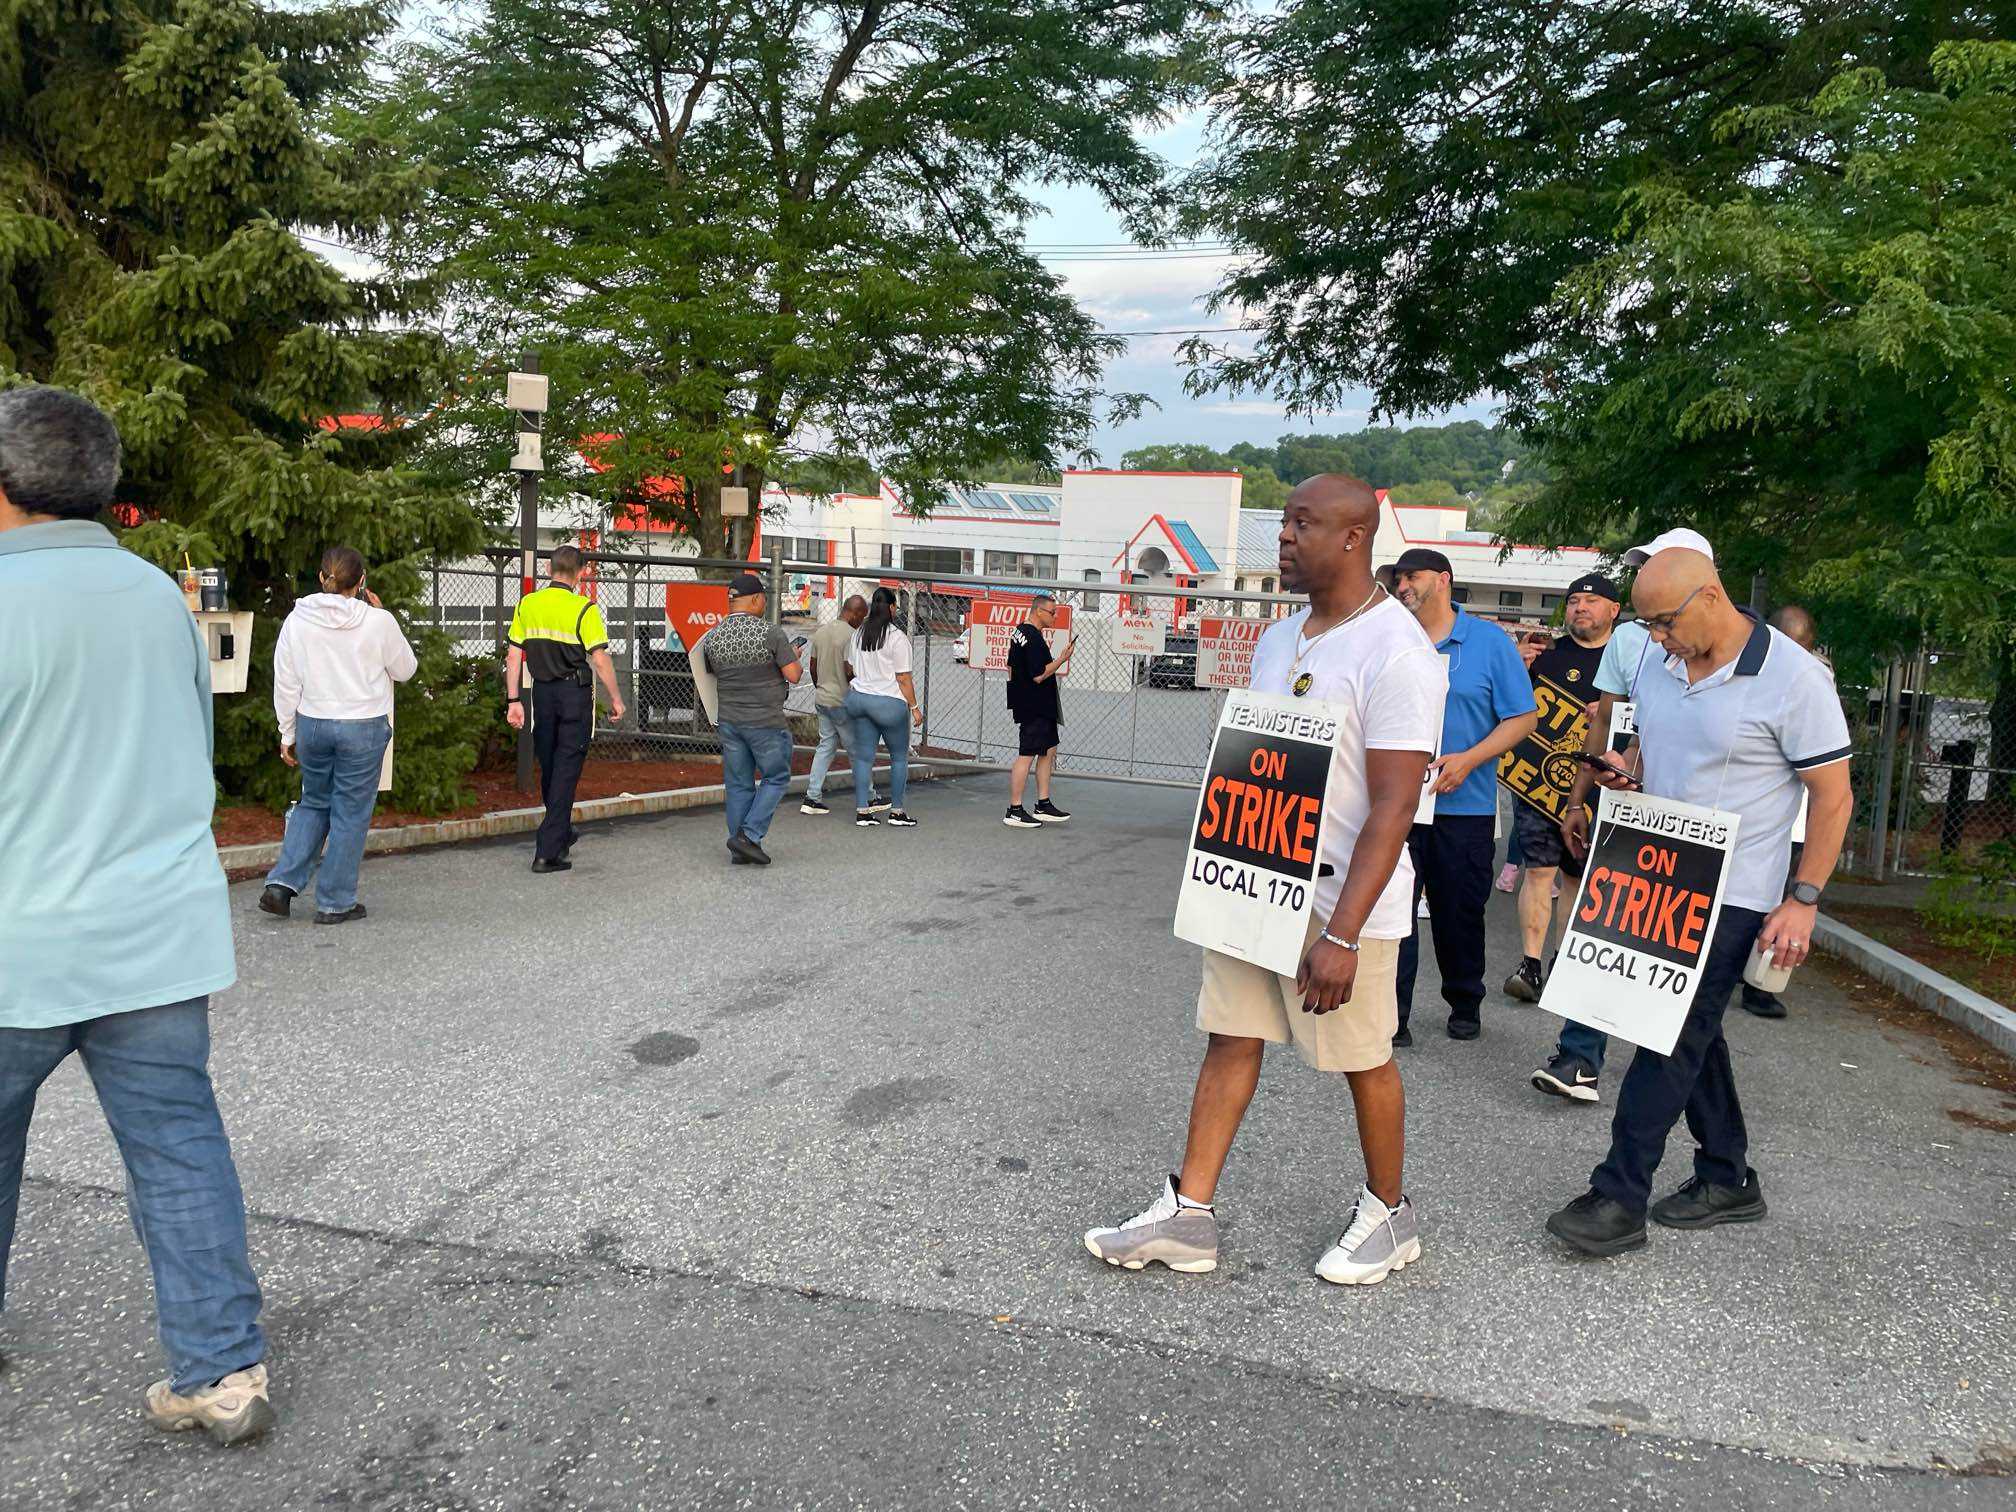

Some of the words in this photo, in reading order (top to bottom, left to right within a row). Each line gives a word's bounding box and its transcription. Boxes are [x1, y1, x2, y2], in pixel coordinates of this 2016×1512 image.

[989, 605, 1031, 625] NOTI
[985, 625, 1006, 635] THIS
[1219, 621, 1267, 641] NOTI
[986, 636, 1008, 647] PROT
[1121, 641, 1154, 652] Soliciting
[1202, 640, 1216, 650] NO
[1219, 641, 1258, 652] ALCOHO
[1217, 652, 1231, 662] OR
[1209, 674, 1239, 685] THESE
[1219, 664, 1252, 675] ALLOW
[1230, 704, 1336, 742] TEAMSTERS
[1251, 748, 1287, 781] ON
[1200, 775, 1320, 865] STRIKE
[1609, 800, 1728, 845] TEAMSTERS
[1637, 844, 1678, 877] ON
[1192, 856, 1258, 899] LOCAL
[1268, 878, 1305, 911] 170
[1580, 867, 1711, 954] STRIKE
[1566, 937, 1637, 980] LOCAL
[1649, 964, 1688, 995] 170
